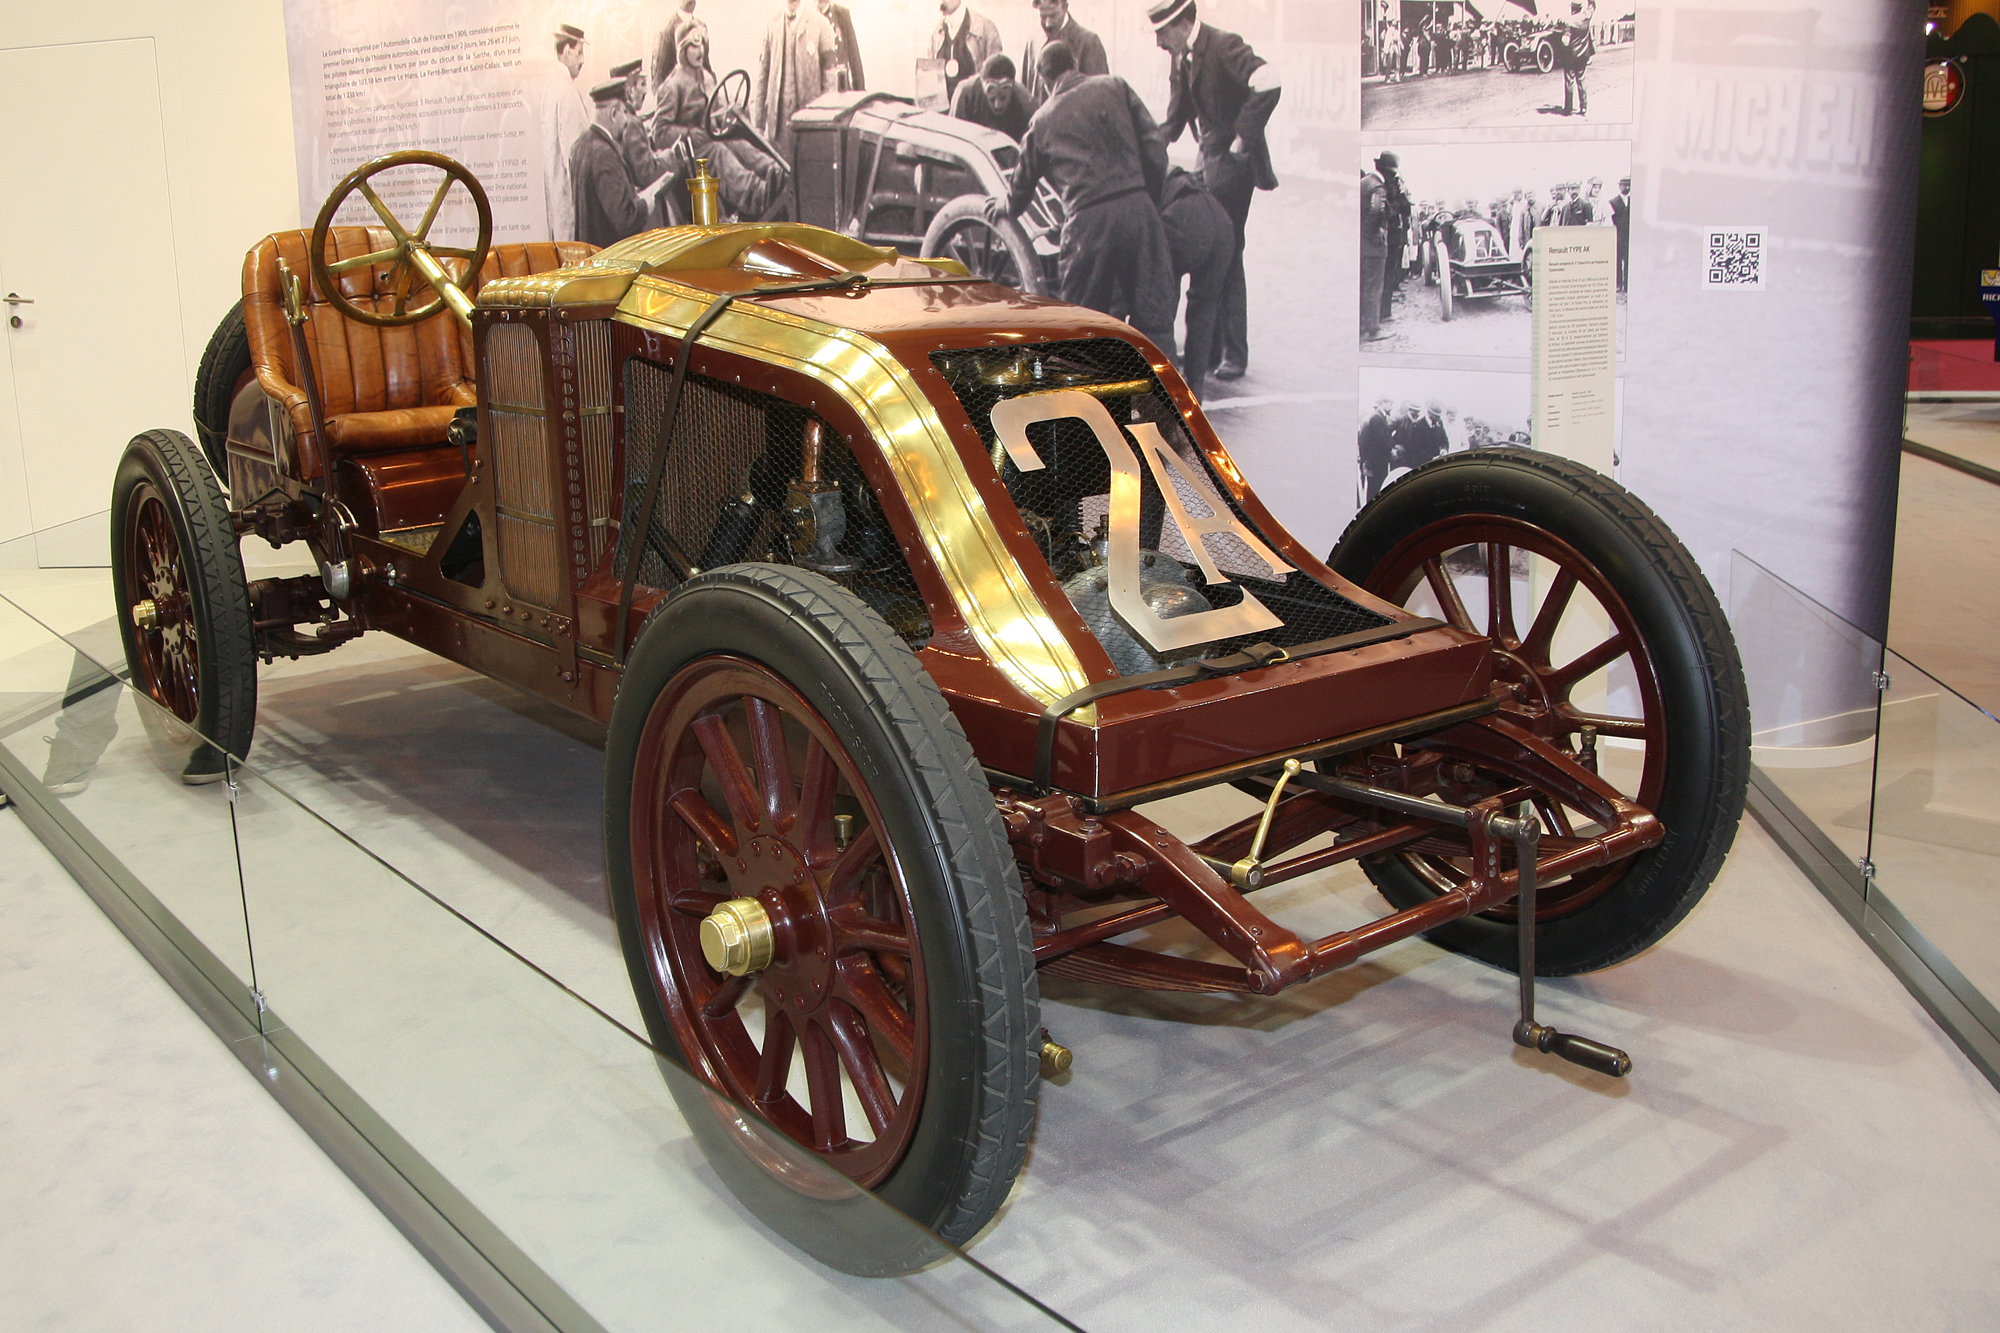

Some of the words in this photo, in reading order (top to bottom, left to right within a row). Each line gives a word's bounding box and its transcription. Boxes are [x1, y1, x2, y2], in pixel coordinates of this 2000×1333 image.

[411, 36, 422, 44] Club
[323, 61, 340, 70] premier
[332, 71, 347, 79] pilotes
[418, 60, 428, 68] jour
[439, 55, 455, 63] circuit
[473, 51, 491, 59] Sarthe,
[507, 46, 521, 54] tracé
[325, 81, 350, 90] triangulaire
[427, 66, 462, 76] Ferté-Bernard
[470, 62, 501, 71] Saint-Calais,
[503, 59, 513, 67] soit
